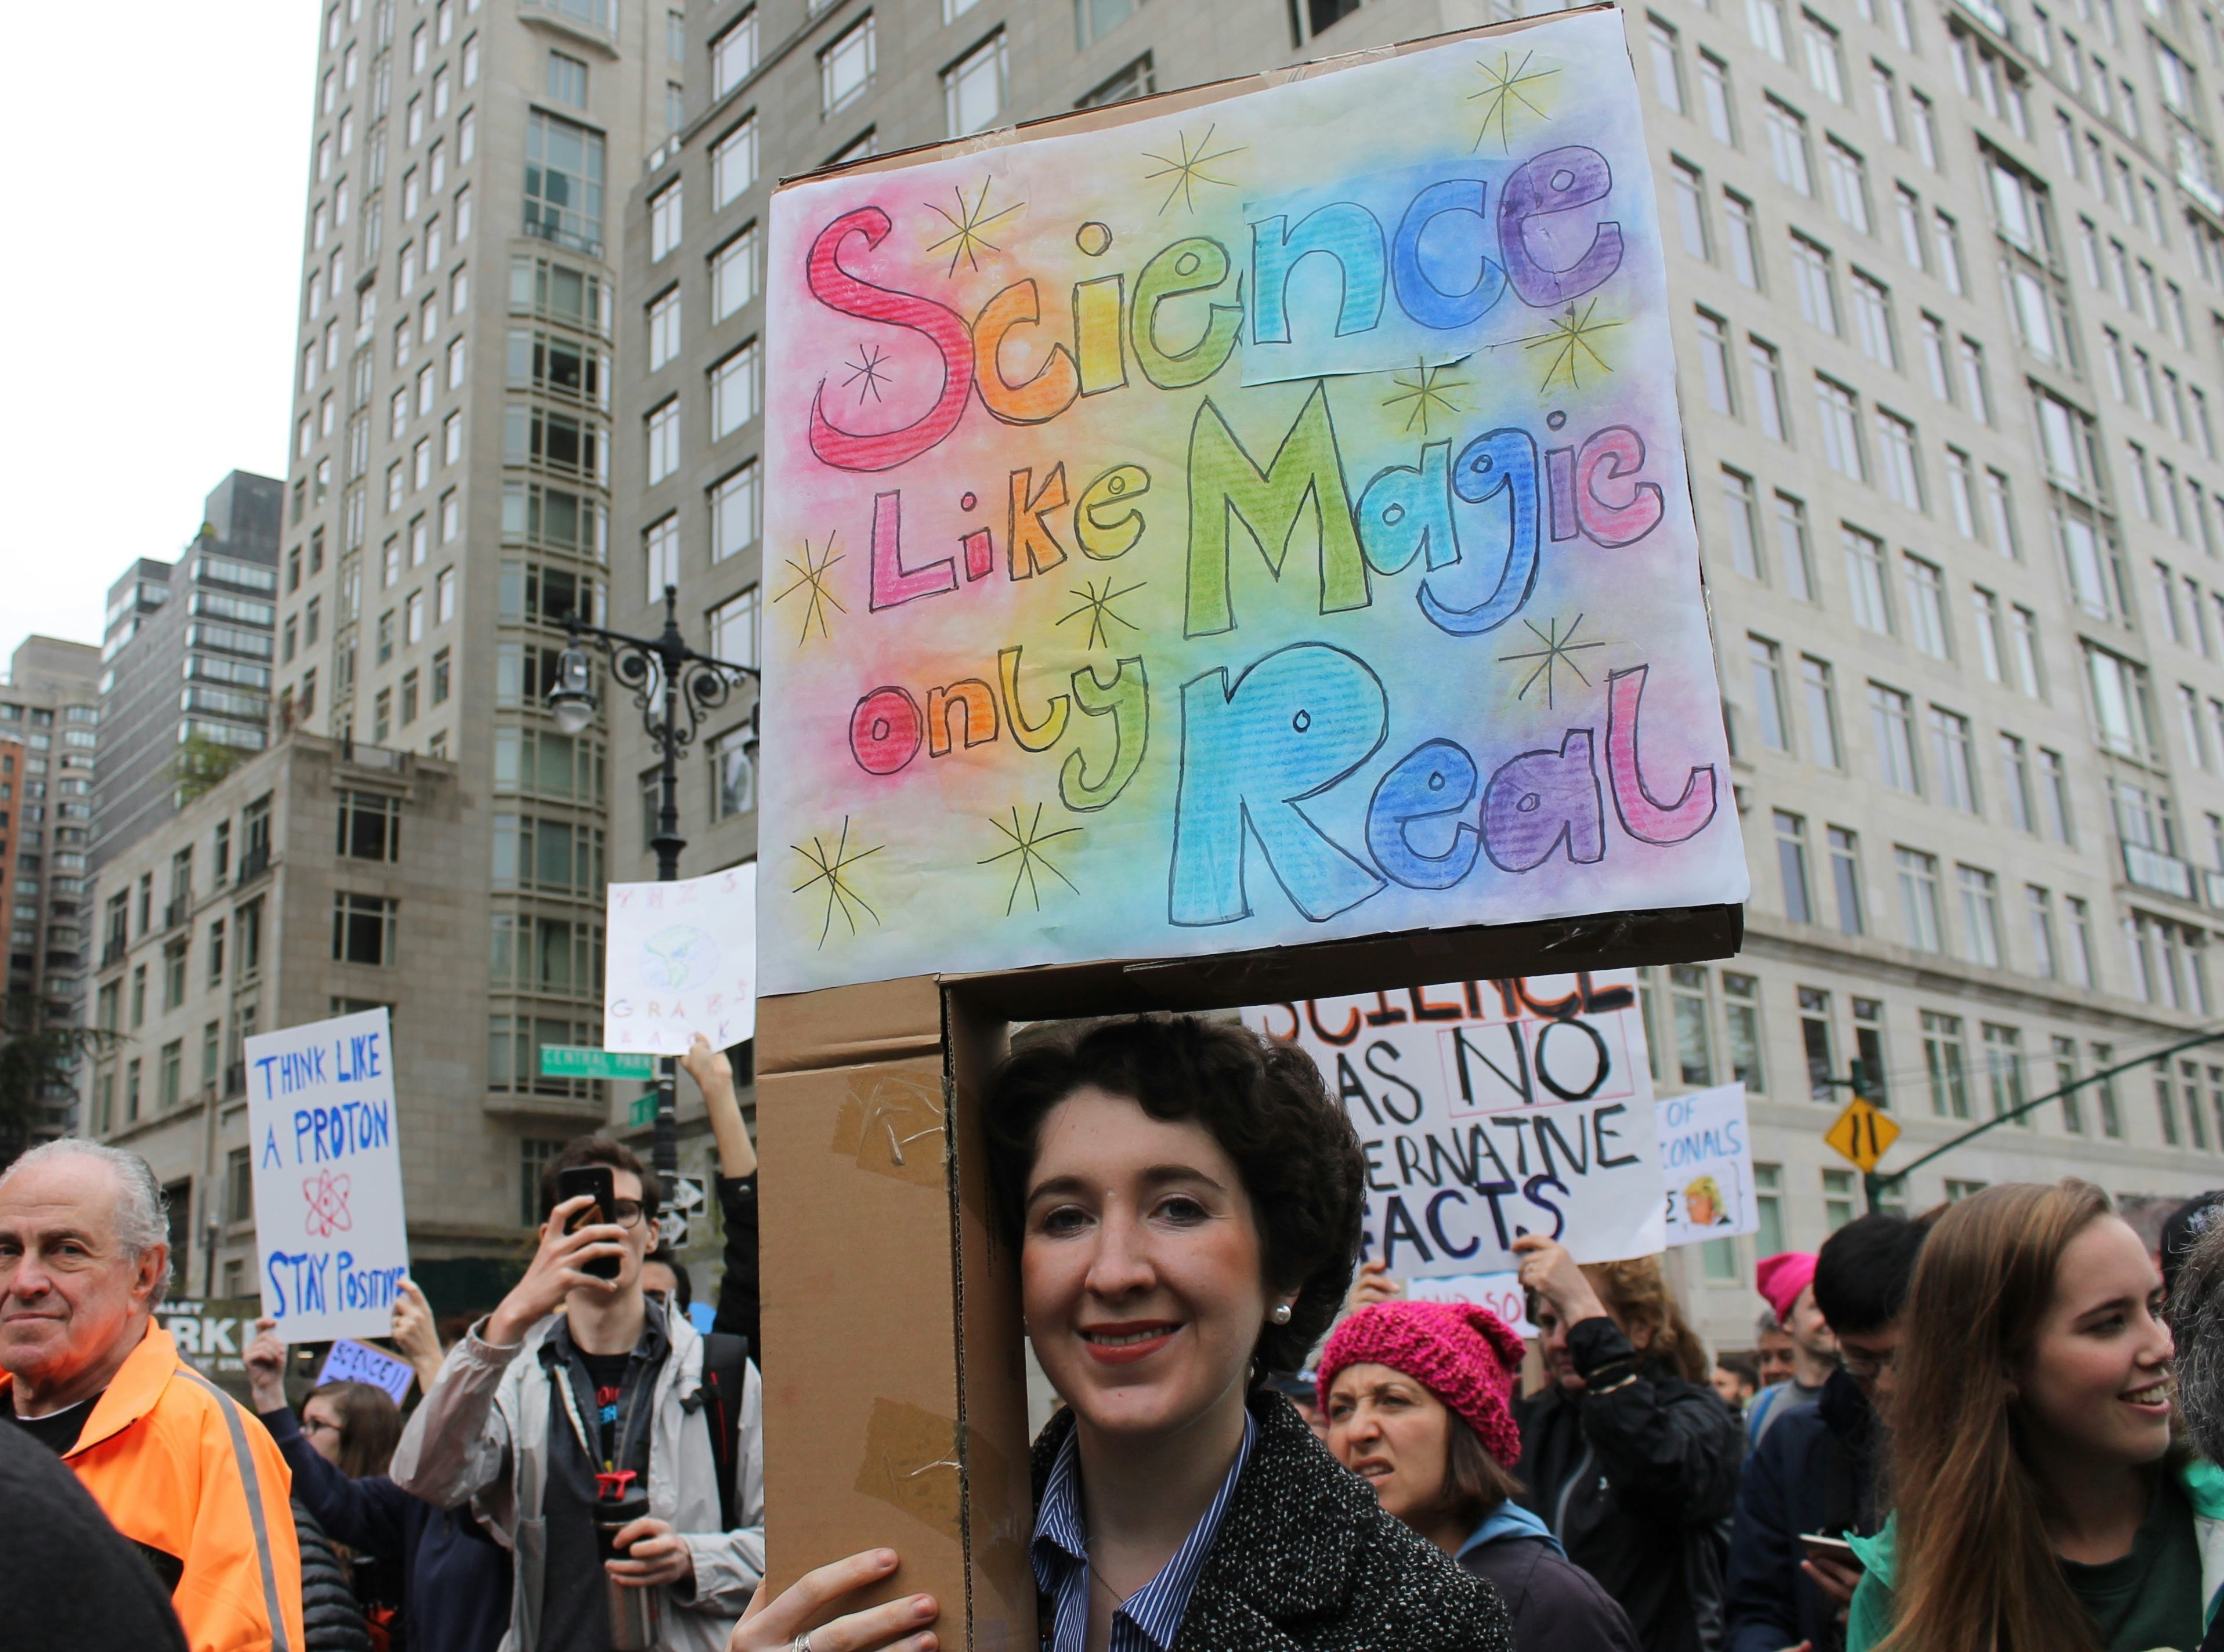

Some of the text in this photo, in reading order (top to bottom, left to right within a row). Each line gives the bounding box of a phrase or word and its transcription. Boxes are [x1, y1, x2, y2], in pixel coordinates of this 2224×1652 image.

[807, 146, 1622, 471] Science
[1184, 379, 1664, 639] Magic
[849, 642, 1717, 927] only Real
[254, 1032, 382, 1100] THINK LIKE
[1336, 1017, 1611, 1124] AS NO
[262, 1100, 389, 1170] A PROTON
[1668, 1096, 1699, 1127] OF
[268, 1251, 330, 1318] STAY
